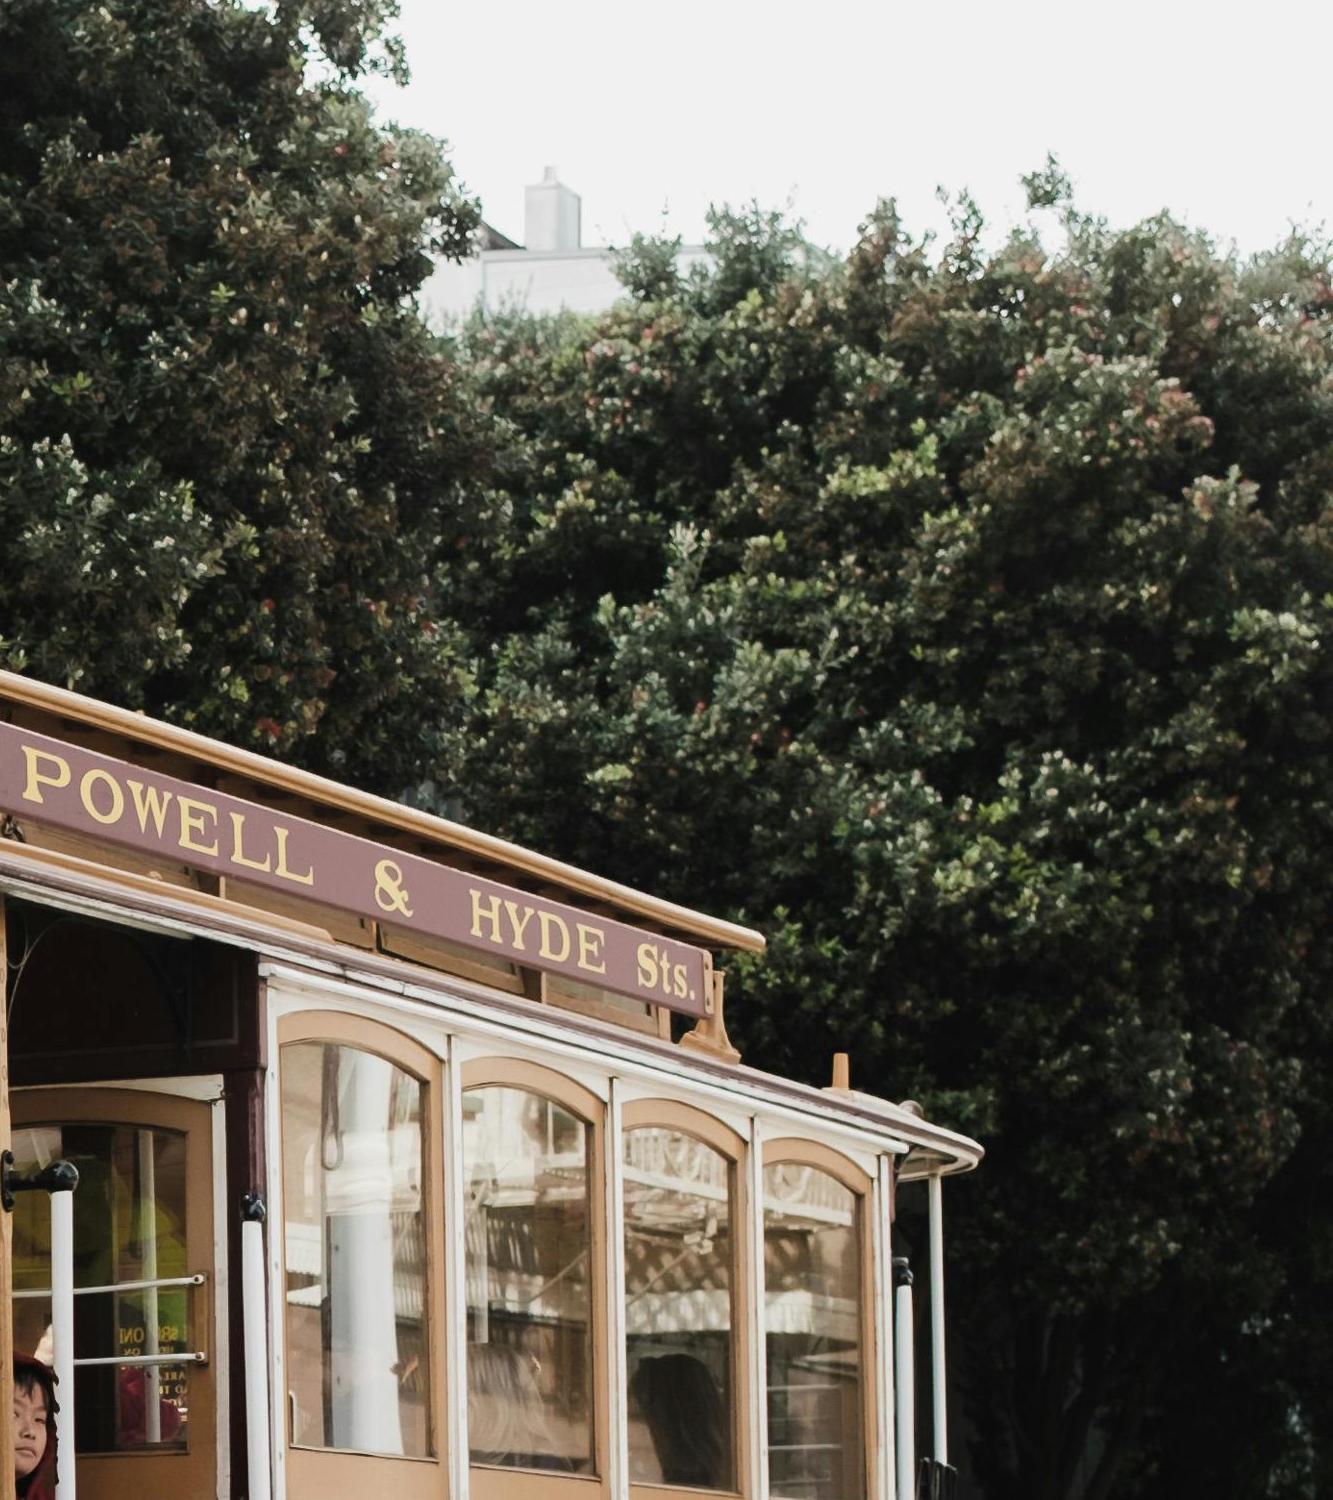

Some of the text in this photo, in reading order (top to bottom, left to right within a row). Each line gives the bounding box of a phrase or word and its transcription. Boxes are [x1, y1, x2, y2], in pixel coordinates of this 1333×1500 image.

[19, 744, 696, 1000] POWELL & HYDE Sts.
